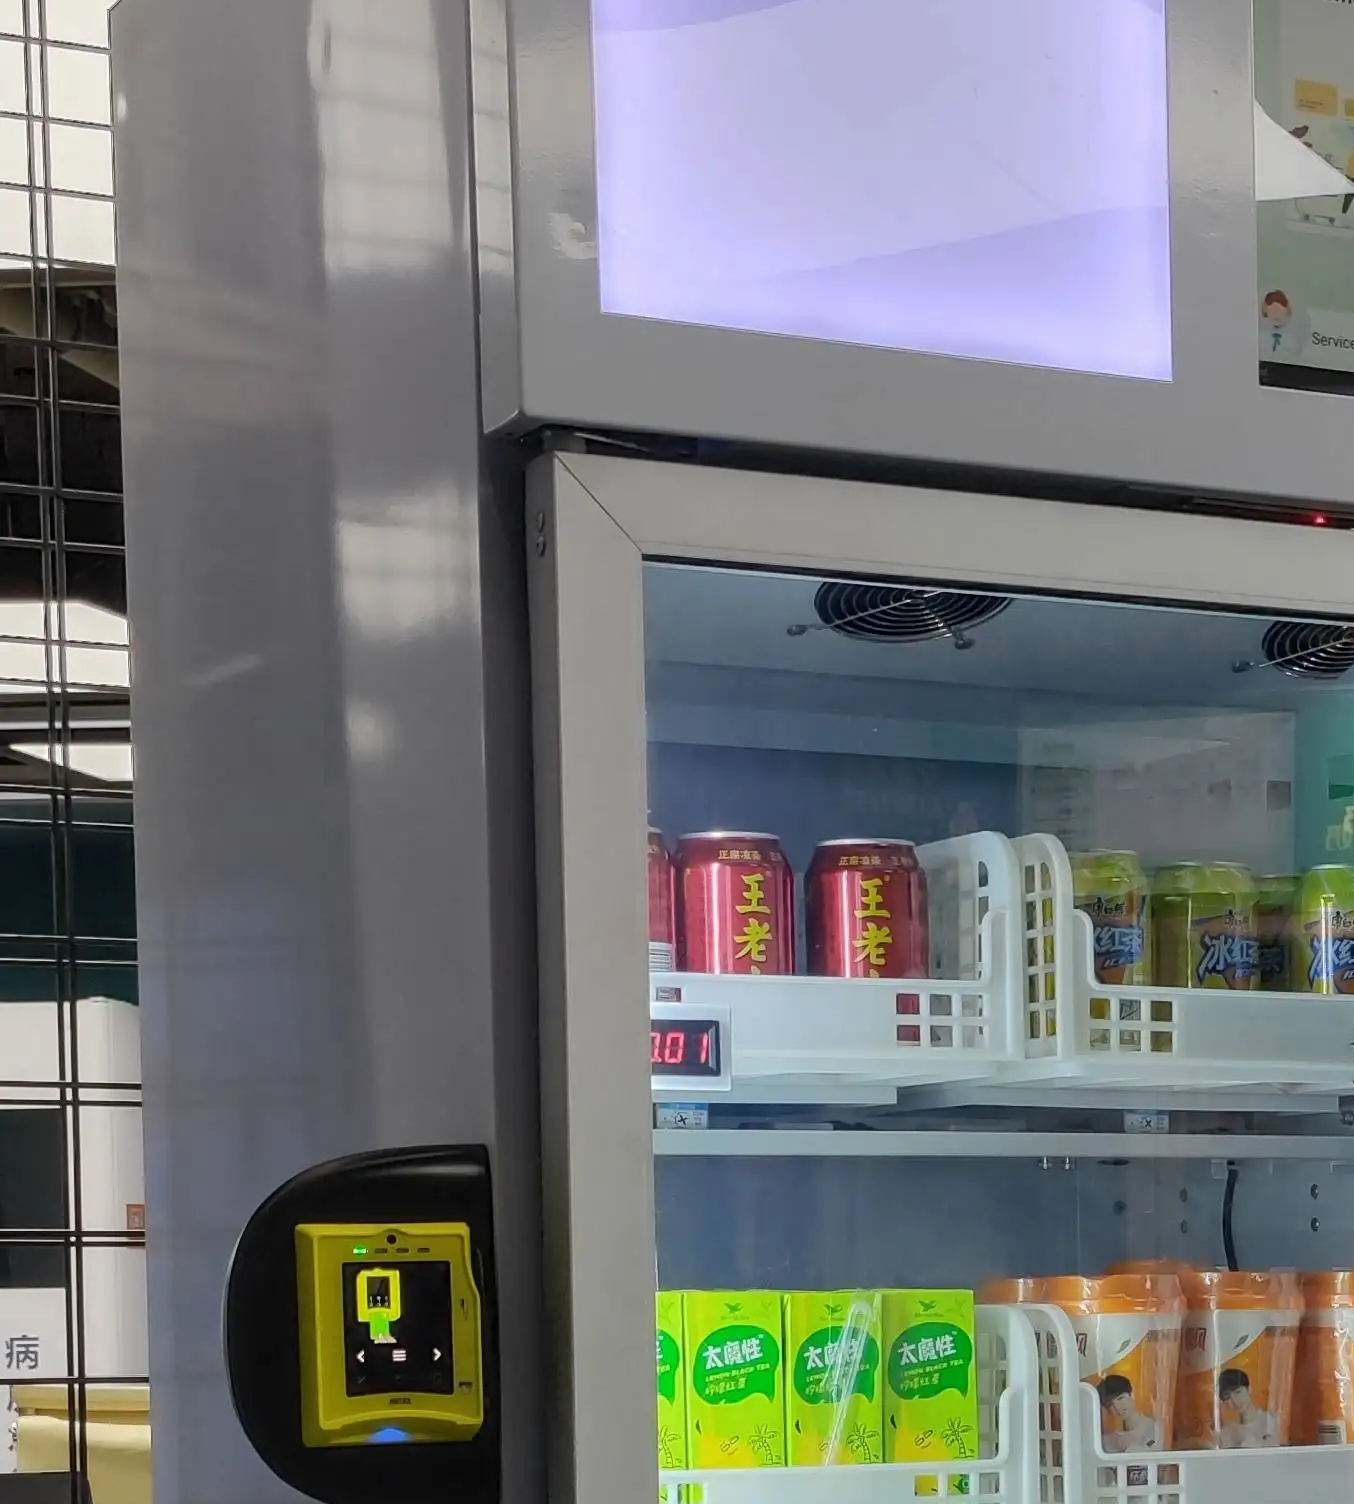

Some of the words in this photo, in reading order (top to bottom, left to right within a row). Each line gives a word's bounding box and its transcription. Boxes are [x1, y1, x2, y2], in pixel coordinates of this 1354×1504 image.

[734, 872, 772, 975] 王老
[852, 877, 893, 978] 王老
[1094, 926, 1144, 956] 红茶
[5, 1334, 40, 1371] 病
[702, 1337, 763, 1370] 太魔性
[897, 1334, 957, 1366] 太魔性
